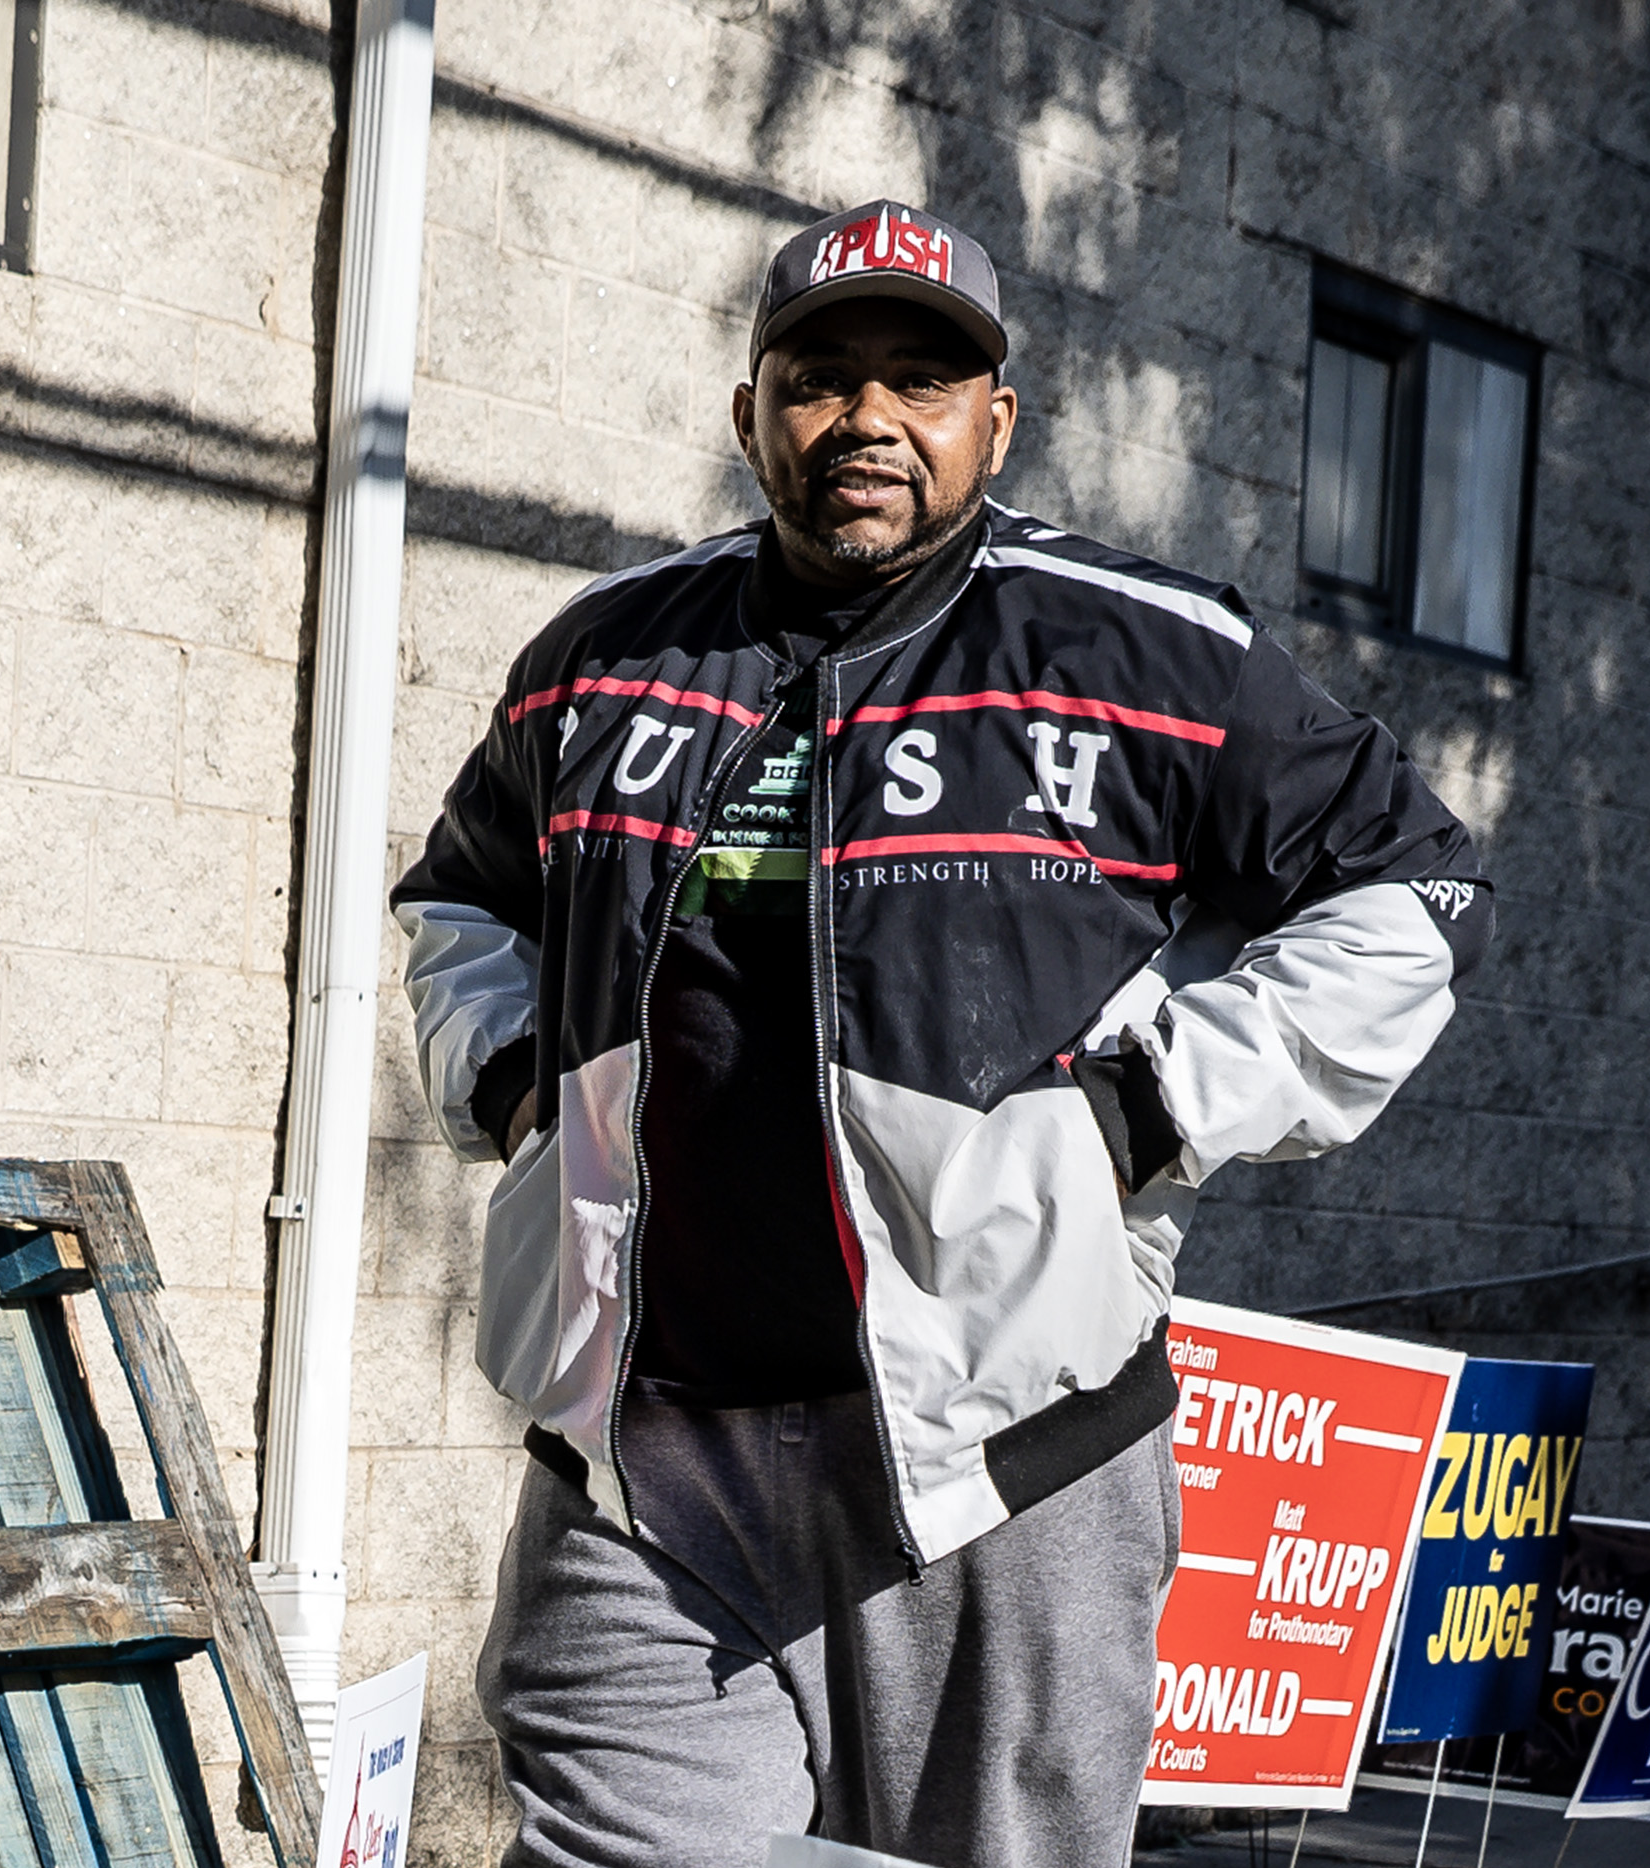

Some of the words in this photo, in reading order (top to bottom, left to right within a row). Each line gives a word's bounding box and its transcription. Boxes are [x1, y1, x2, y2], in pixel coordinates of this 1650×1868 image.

[834, 213, 952, 286] PUSH
[838, 860, 990, 890] STRENGTH
[1031, 858, 1102, 885] HOPE
[1166, 1334, 1219, 1371] raham
[1172, 1373, 1338, 1467] ETRICK
[1175, 1460, 1222, 1490] roner
[1422, 1432, 1582, 1540] ZUGAY
[1273, 1499, 1306, 1532] Matt
[1255, 1534, 1390, 1612] KRUPP
[1426, 1583, 1540, 1665] JUDGE
[1556, 1585, 1643, 1620] Marie
[1247, 1610, 1269, 1640] for
[1267, 1611, 1353, 1655] Prothonotary
[1154, 1660, 1301, 1737] DONALD
[1160, 1739, 1208, 1772] Courts
